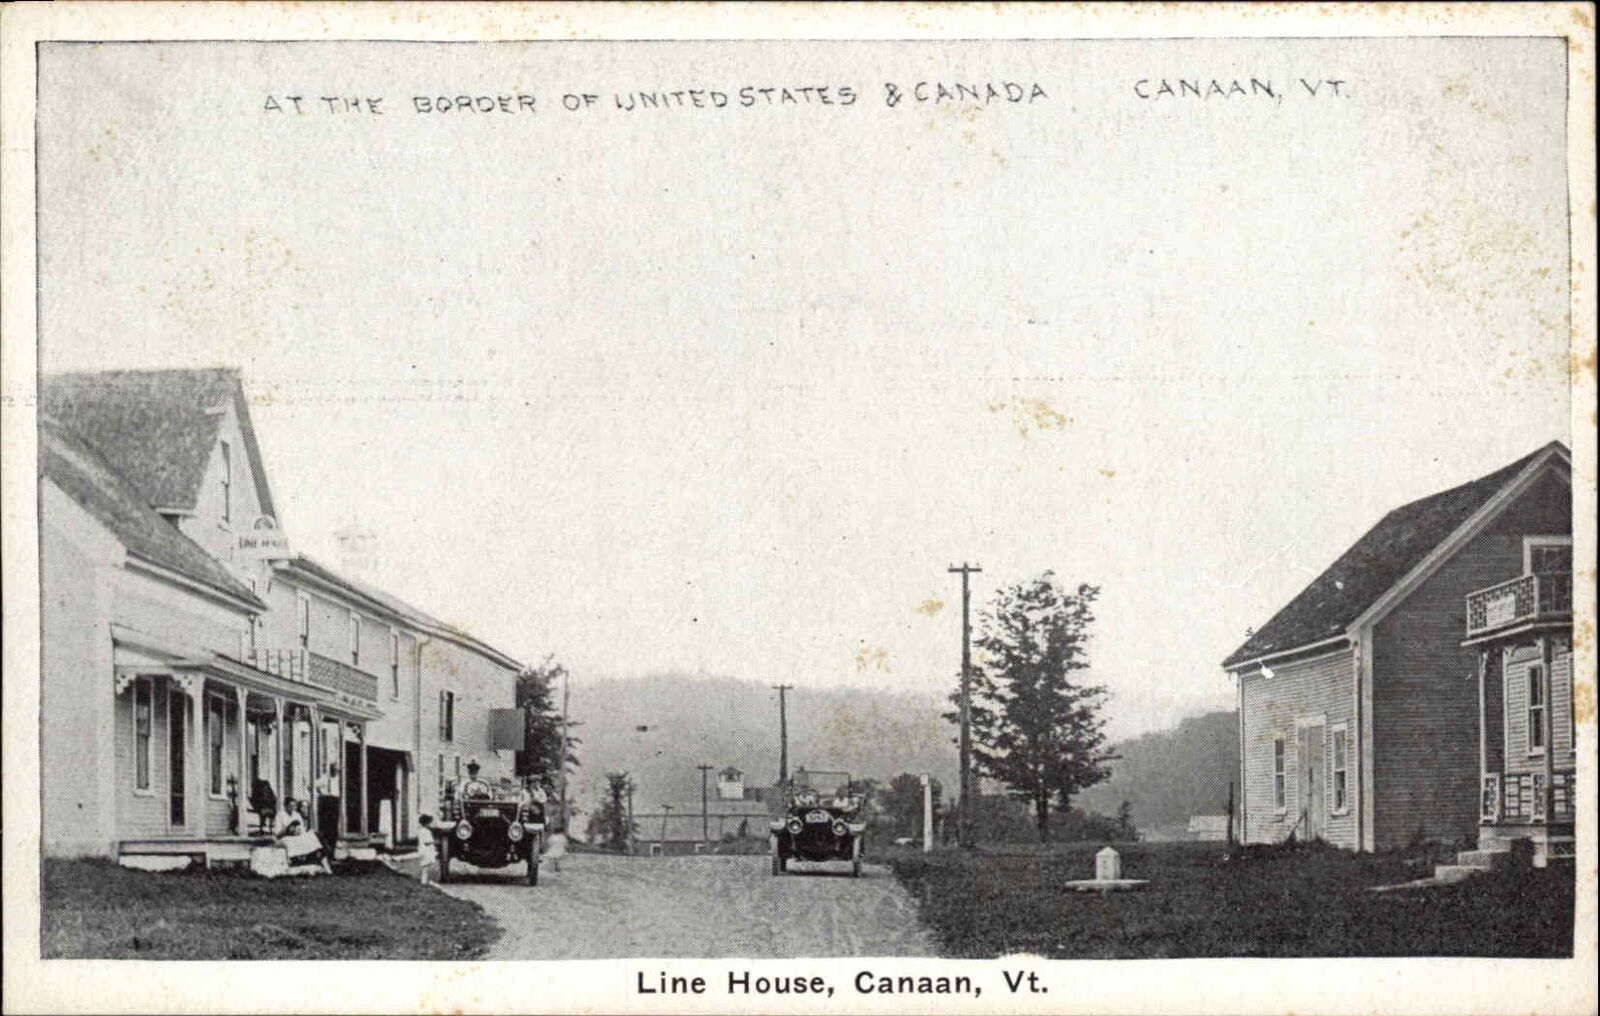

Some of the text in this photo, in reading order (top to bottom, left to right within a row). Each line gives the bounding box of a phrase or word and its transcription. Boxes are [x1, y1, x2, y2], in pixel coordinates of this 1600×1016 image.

[264, 78, 1350, 114] AT THE BORDER OF UNITED STATES & CANADA CANAAN, VT.
